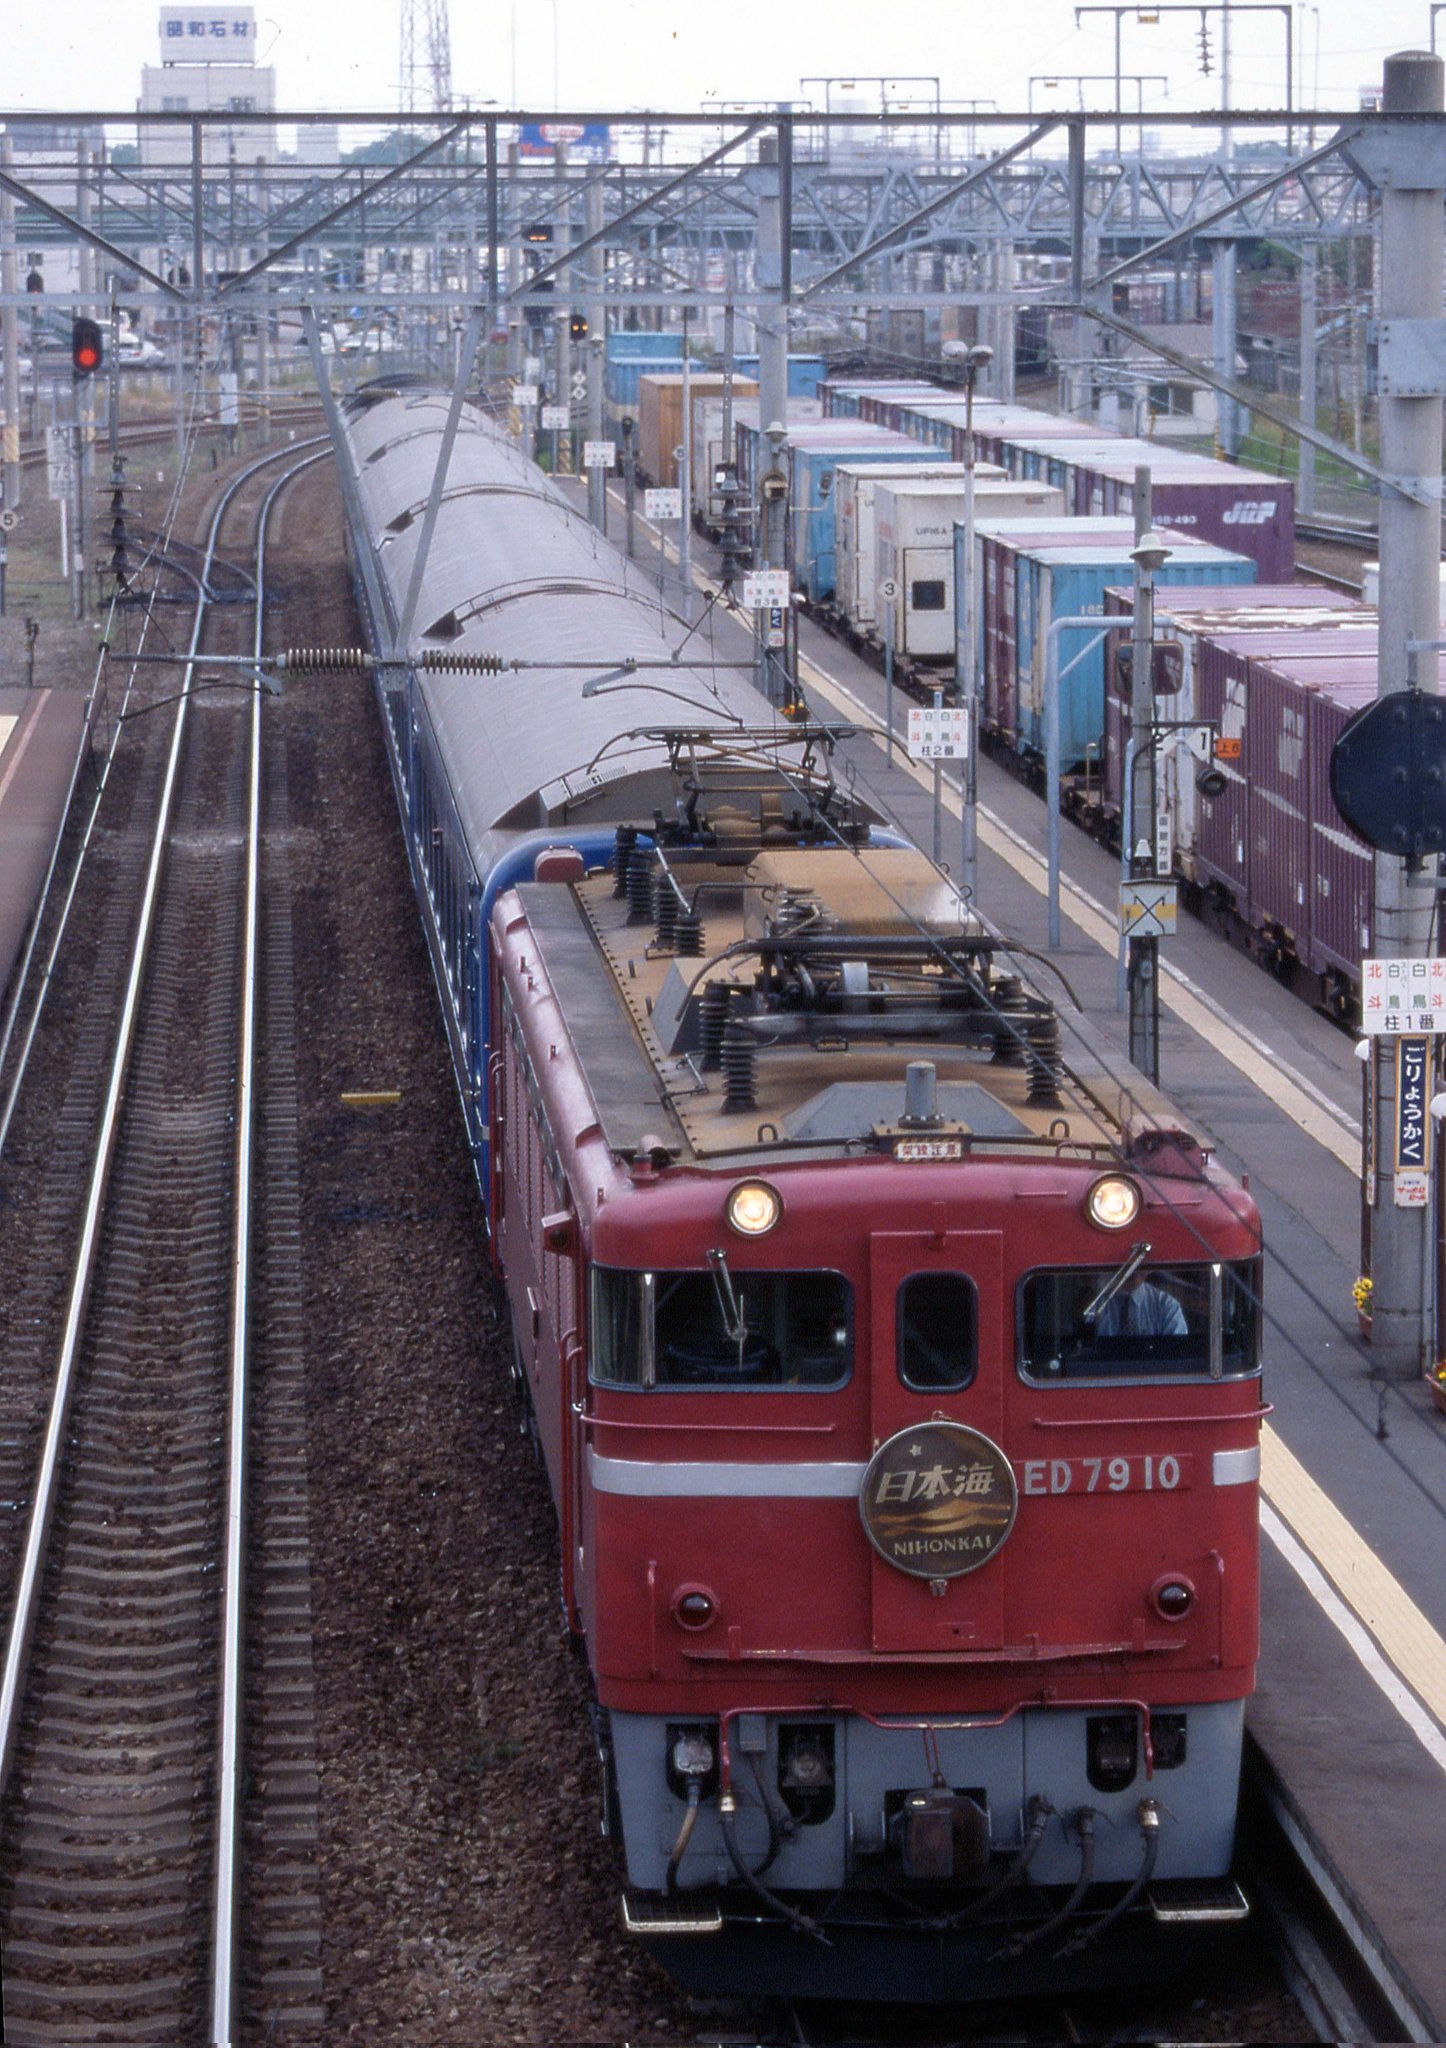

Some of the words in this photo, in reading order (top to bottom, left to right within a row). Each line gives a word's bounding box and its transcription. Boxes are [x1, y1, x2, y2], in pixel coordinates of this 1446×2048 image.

[3, 513, 14, 526] 5
[1222, 501, 1277, 524] JRF
[884, 582, 895, 596] 3
[921, 745, 954, 757] 柱2番
[1384, 1014, 1435, 1031] 柱1番
[1403, 1046, 1426, 1160] ごりょうかく
[874, 1462, 996, 1504] 日本海
[1024, 1460, 1072, 1495] ED
[1082, 1457, 1130, 1492] 79
[1144, 1455, 1181, 1490] 10
[893, 1535, 993, 1556] NIHONKAI
